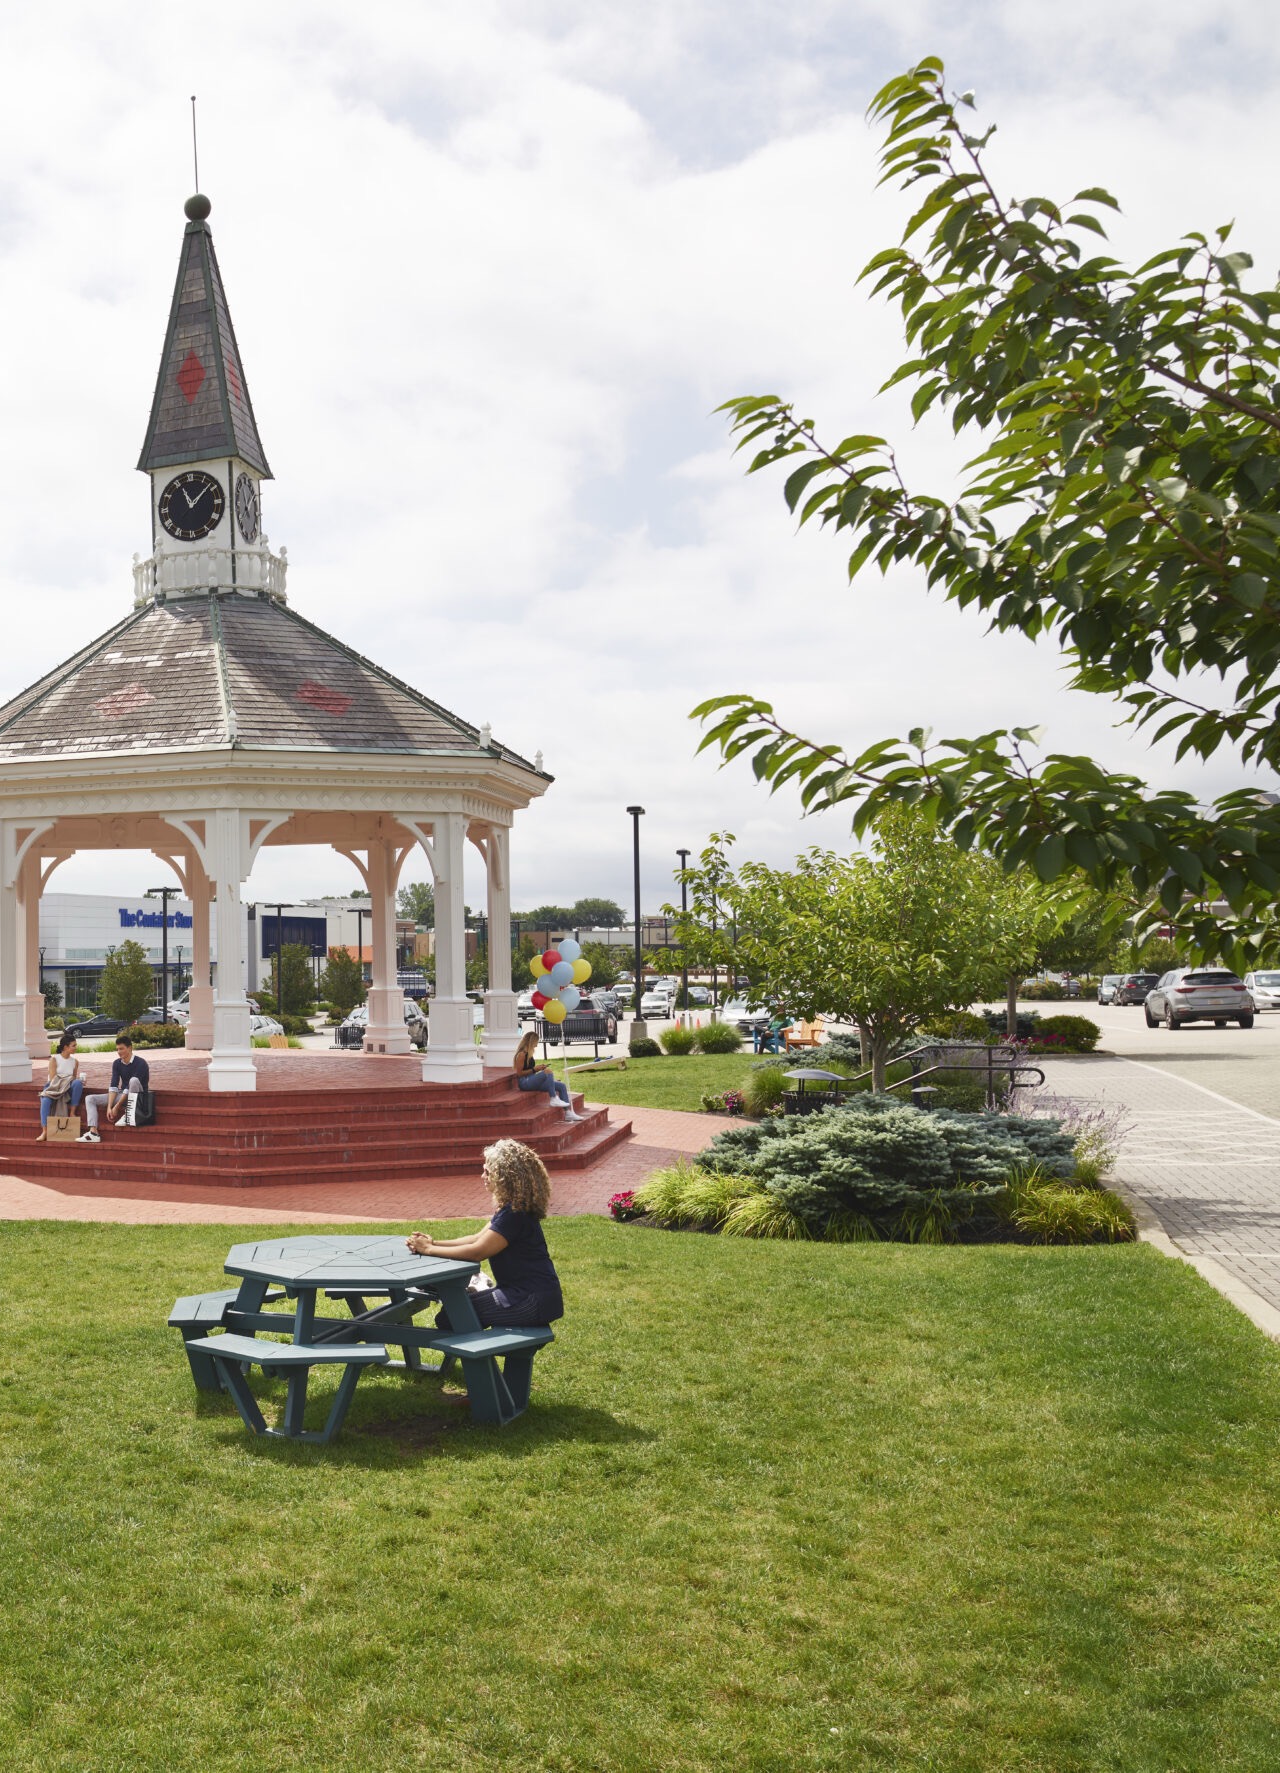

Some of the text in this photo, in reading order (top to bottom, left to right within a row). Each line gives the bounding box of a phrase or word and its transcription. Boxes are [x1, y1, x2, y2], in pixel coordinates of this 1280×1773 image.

[119, 909, 193, 928] The Contaier Stor
